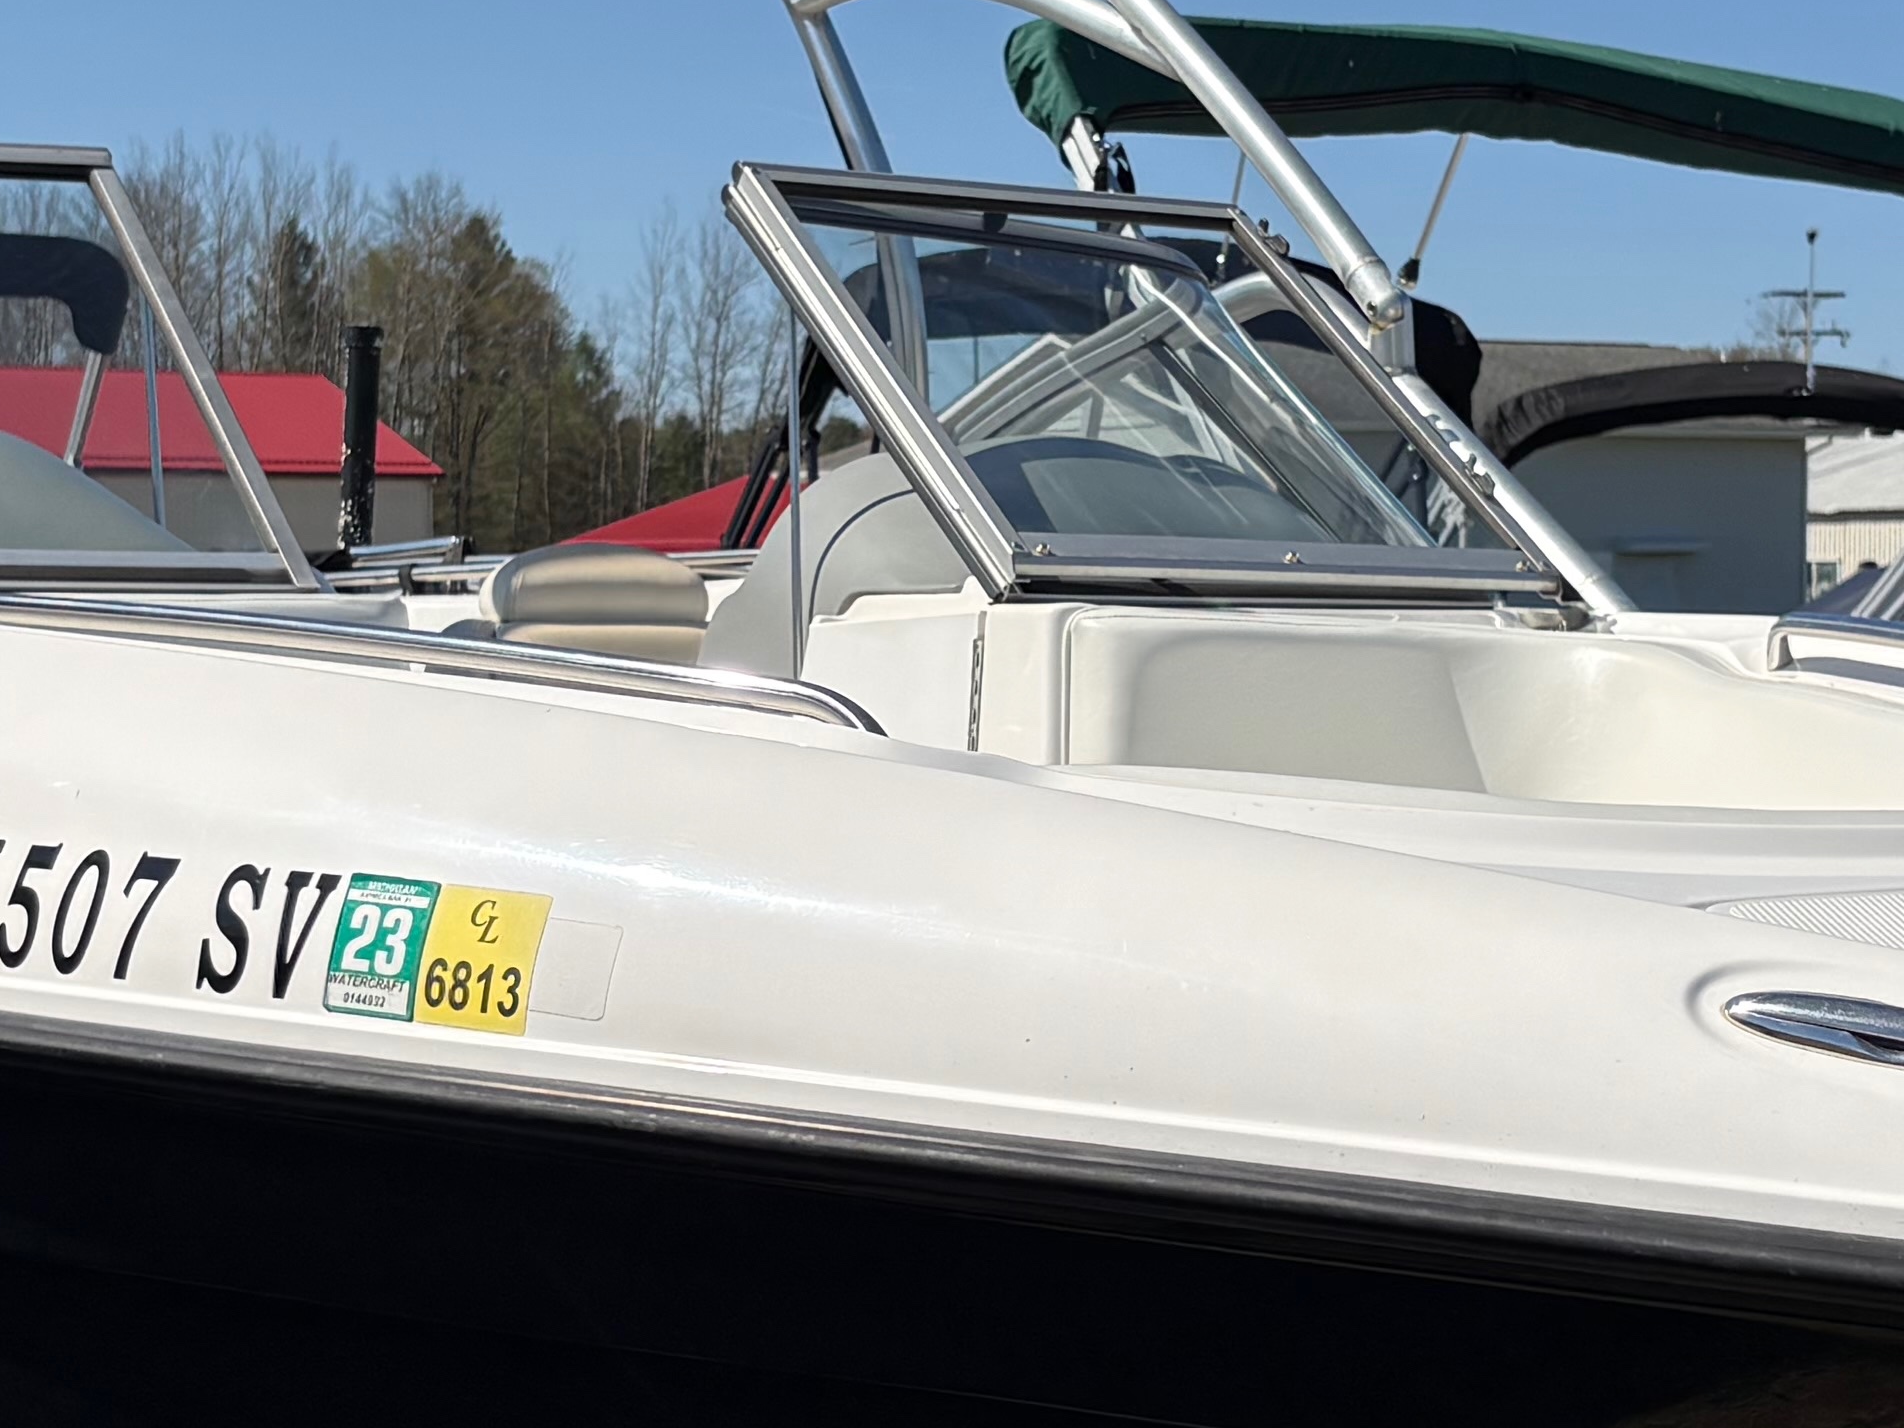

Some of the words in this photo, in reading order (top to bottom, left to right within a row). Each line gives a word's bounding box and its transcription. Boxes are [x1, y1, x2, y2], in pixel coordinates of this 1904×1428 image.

[196, 864, 342, 999] SV
[340, 904, 414, 977] 23
[328, 972, 406, 992] WATERCRAFT
[424, 957, 522, 1017] 6813
